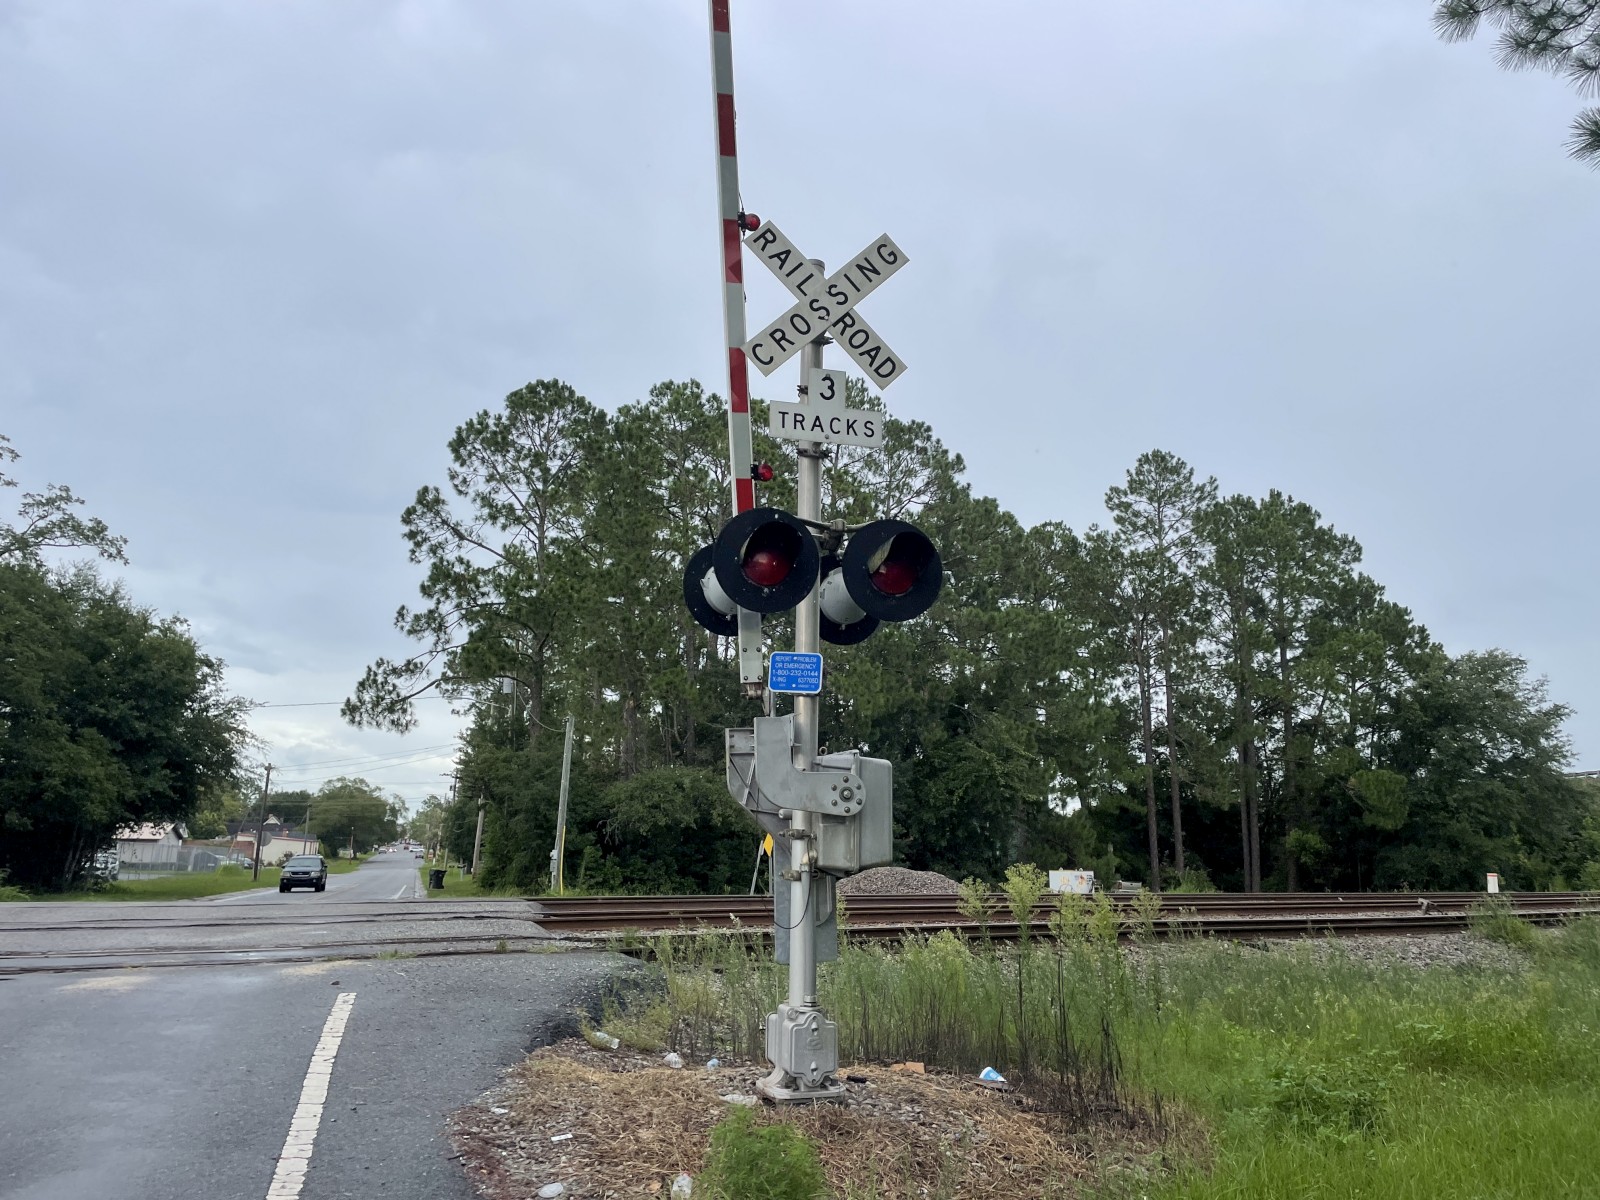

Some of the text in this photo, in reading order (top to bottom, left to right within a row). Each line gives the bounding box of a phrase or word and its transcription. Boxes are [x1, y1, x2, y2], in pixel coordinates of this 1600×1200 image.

[751, 243, 898, 366] CROSSING
[819, 376, 835, 401] 3
[778, 411, 875, 438] TRACKS
